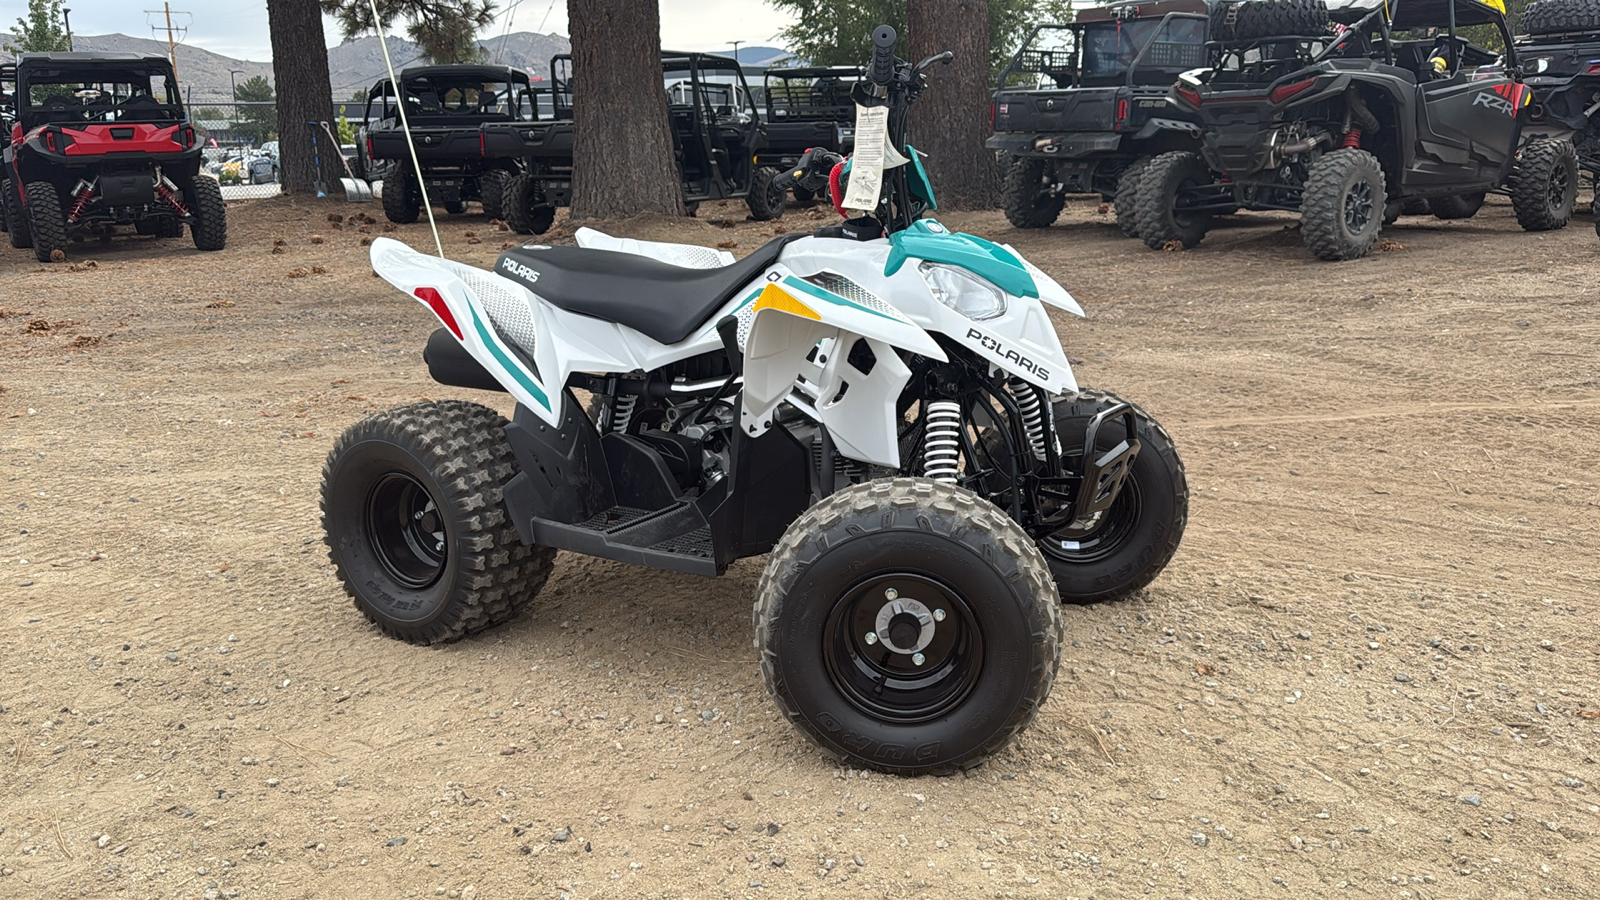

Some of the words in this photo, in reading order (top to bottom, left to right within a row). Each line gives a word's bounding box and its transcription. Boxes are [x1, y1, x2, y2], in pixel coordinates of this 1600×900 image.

[1472, 92, 1514, 117] RZR
[502, 257, 541, 283] POLARIS
[966, 327, 1050, 382] POLARIS
[816, 711, 942, 762] DURO
